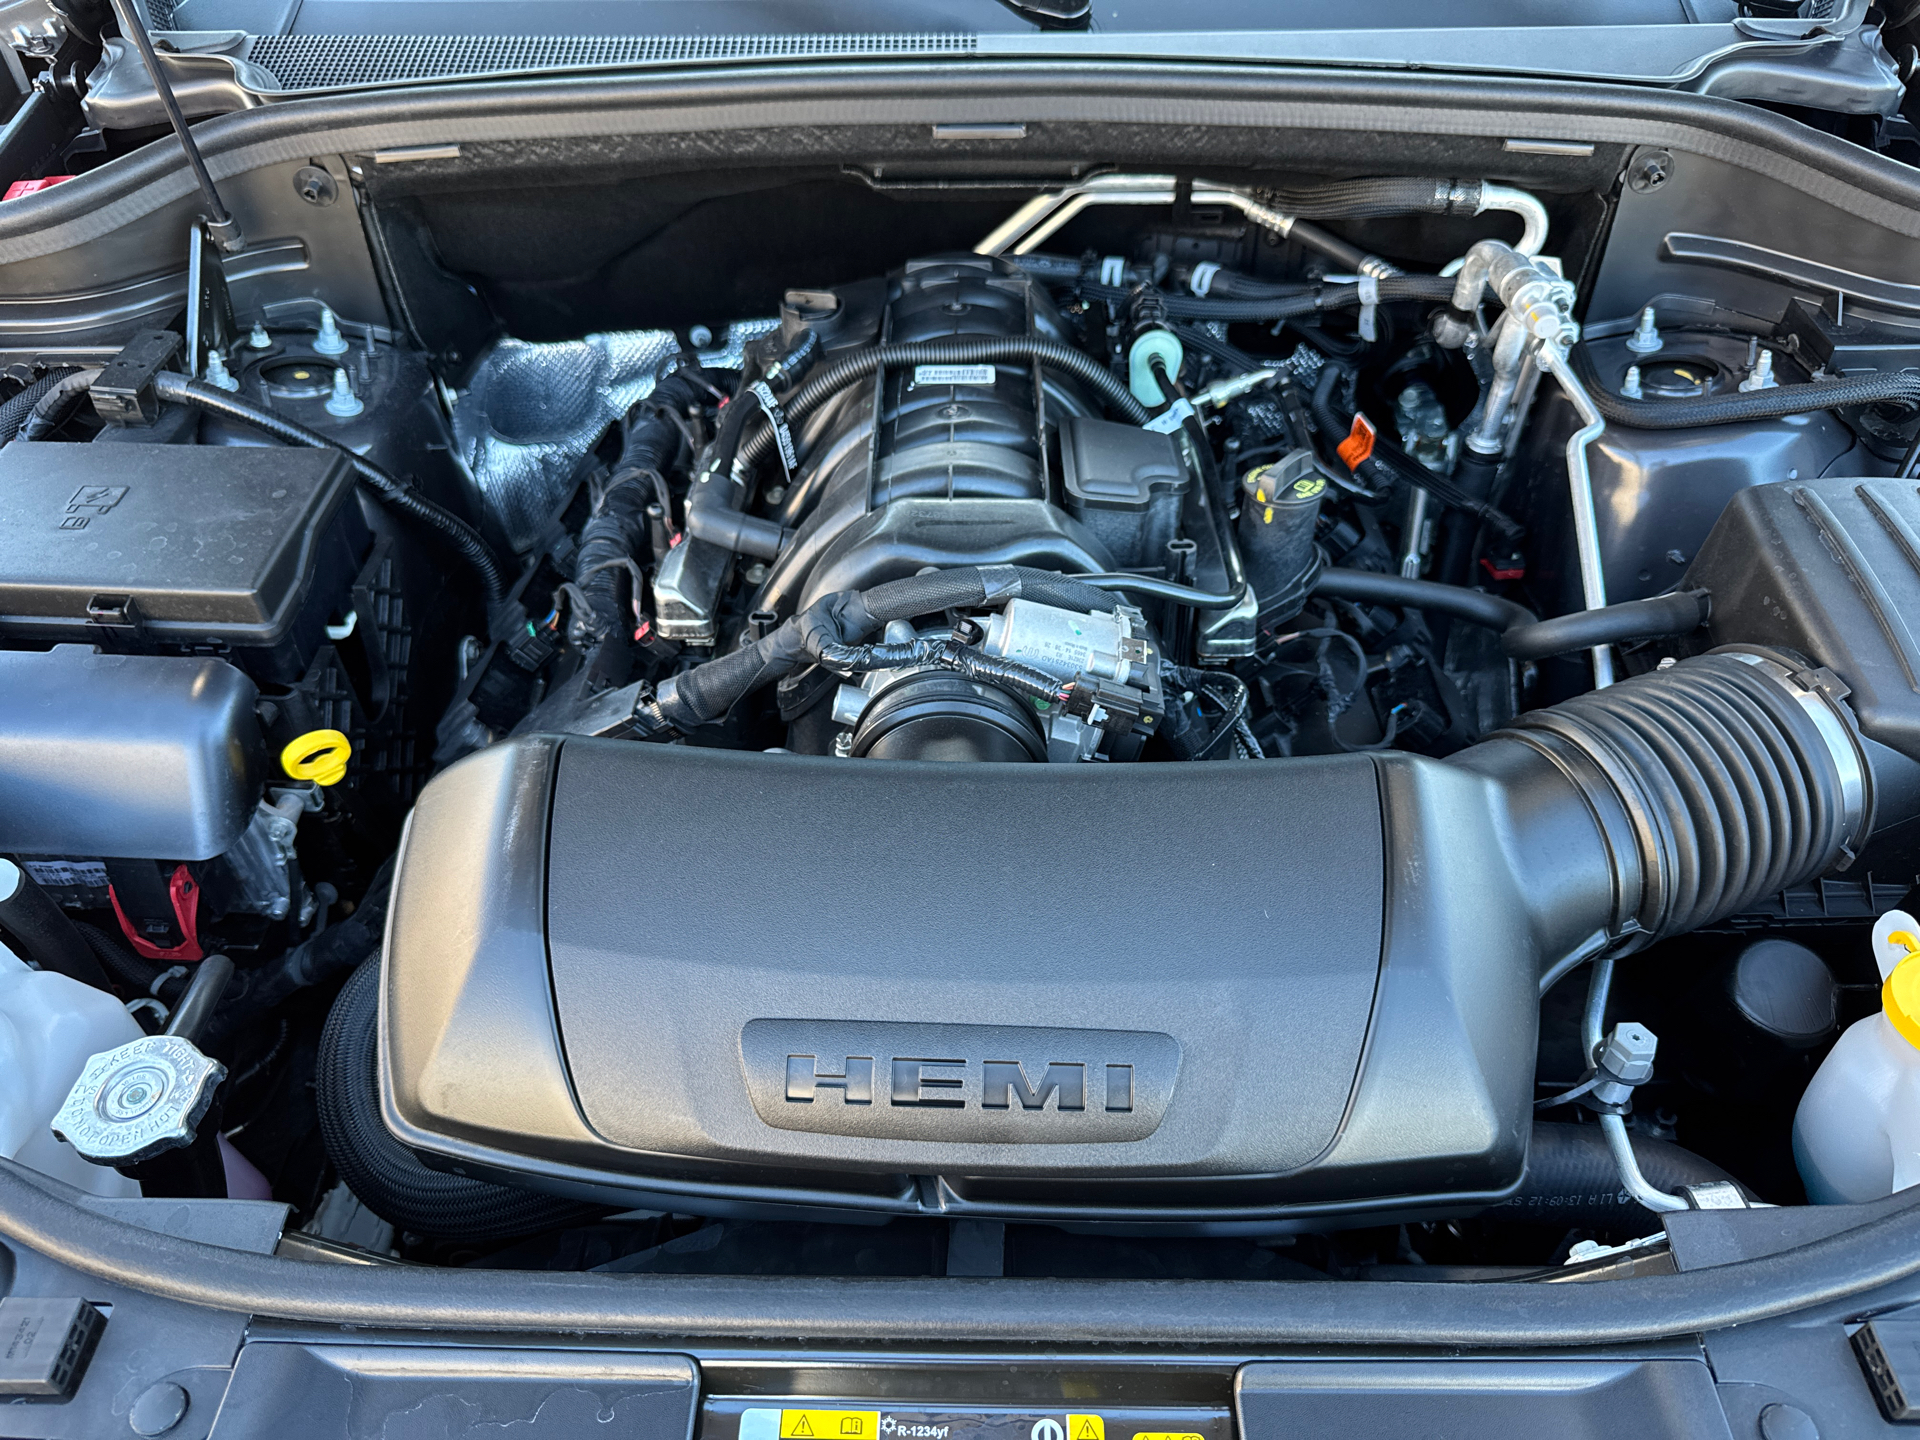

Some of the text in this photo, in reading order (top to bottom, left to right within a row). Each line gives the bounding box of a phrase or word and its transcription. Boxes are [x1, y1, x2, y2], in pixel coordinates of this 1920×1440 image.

[109, 1041, 196, 1071] KEEP TIGHT
[74, 1084, 99, 1095] TVS
[785, 1054, 1135, 1113] HEMI
[70, 1096, 86, 1117] DO
[150, 1104, 179, 1132] HOT
[73, 1119, 99, 1143] NOT
[99, 1130, 144, 1147] OPEN
[897, 1425, 949, 1439] R-1234yf
